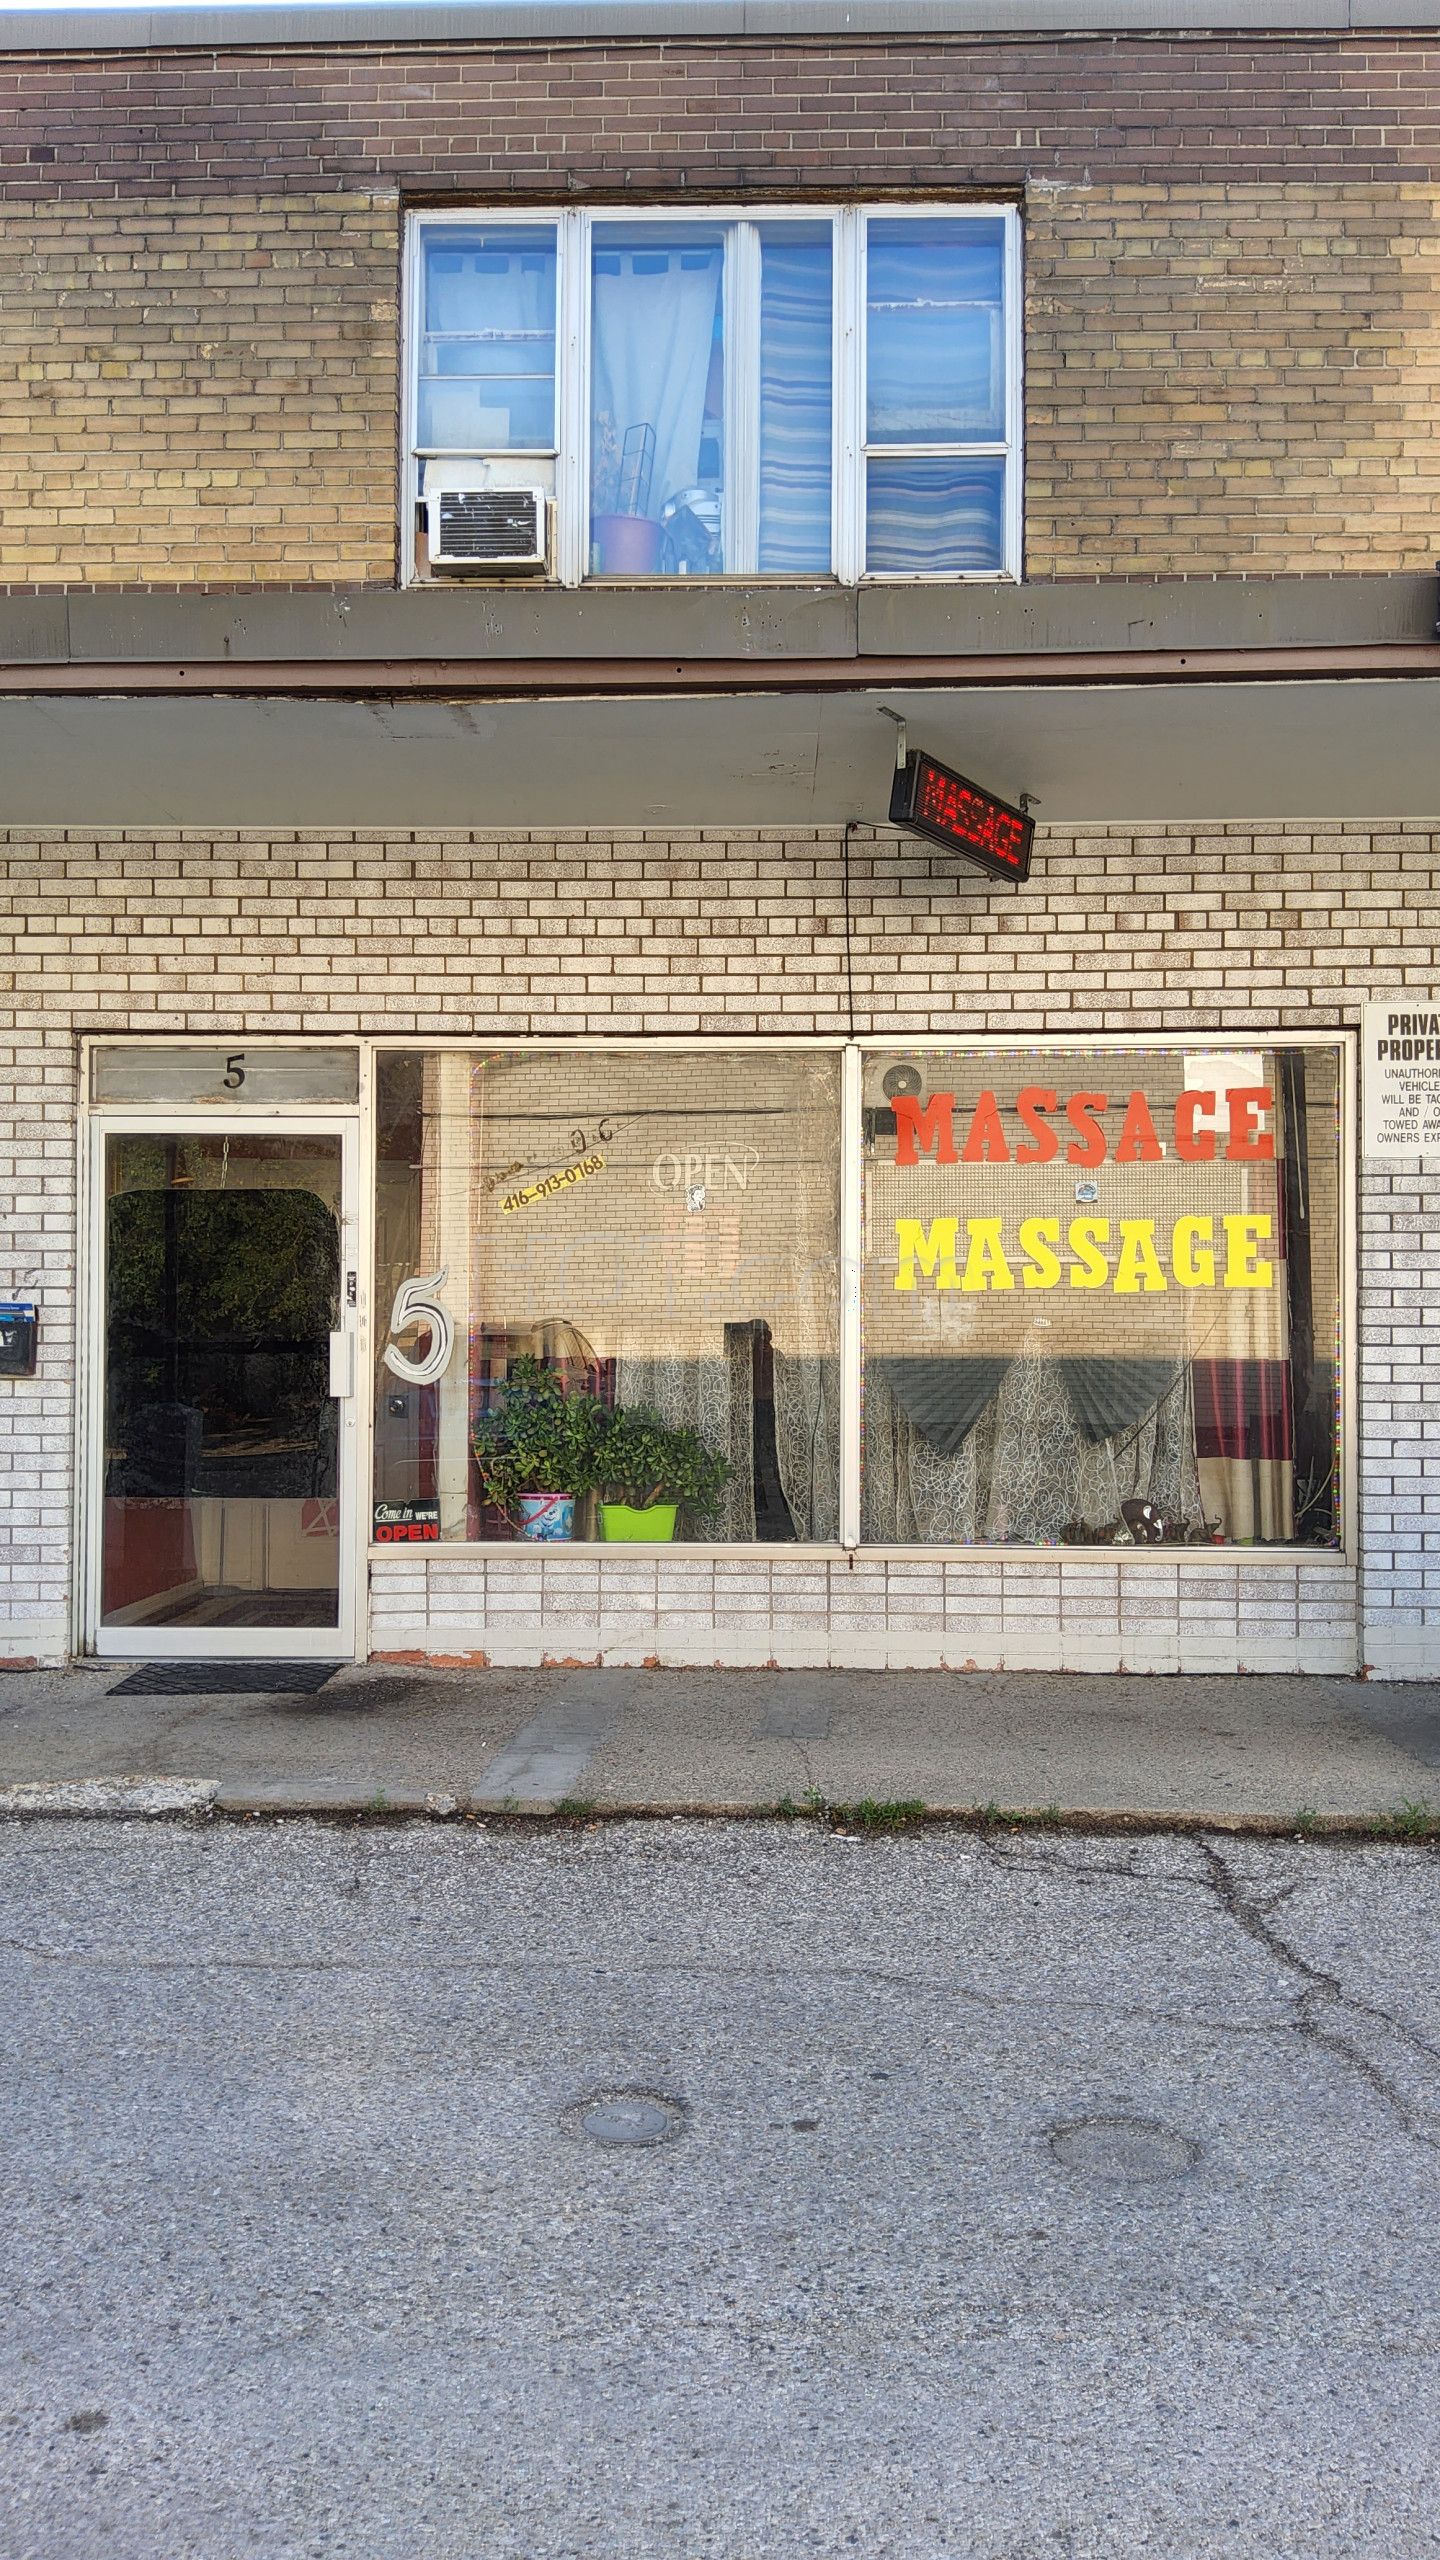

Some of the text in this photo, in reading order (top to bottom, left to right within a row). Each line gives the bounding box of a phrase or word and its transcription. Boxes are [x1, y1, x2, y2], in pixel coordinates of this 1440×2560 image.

[923, 769, 1023, 866] MASSAGE
[1388, 1014, 1440, 1035] PRIVA
[223, 1053, 245, 1089] 5
[1381, 1094, 1405, 1104] WILL
[1408, 1094, 1422, 1104] BE
[1399, 1107, 1420, 1117] AND
[891, 1086, 1275, 1169] MASSAGE
[1377, 1132, 1420, 1143] OWNERS
[1383, 1119, 1419, 1130] TOWED
[502, 1154, 605, 1212] 416-913-0768
[652, 1153, 748, 1190] OPEN
[894, 1214, 1273, 1294] MASSAGE
[384, 1264, 455, 1386] 5
[375, 1504, 401, 1519] Come
[402, 1506, 413, 1519] in
[375, 1523, 439, 1543] OPEN
